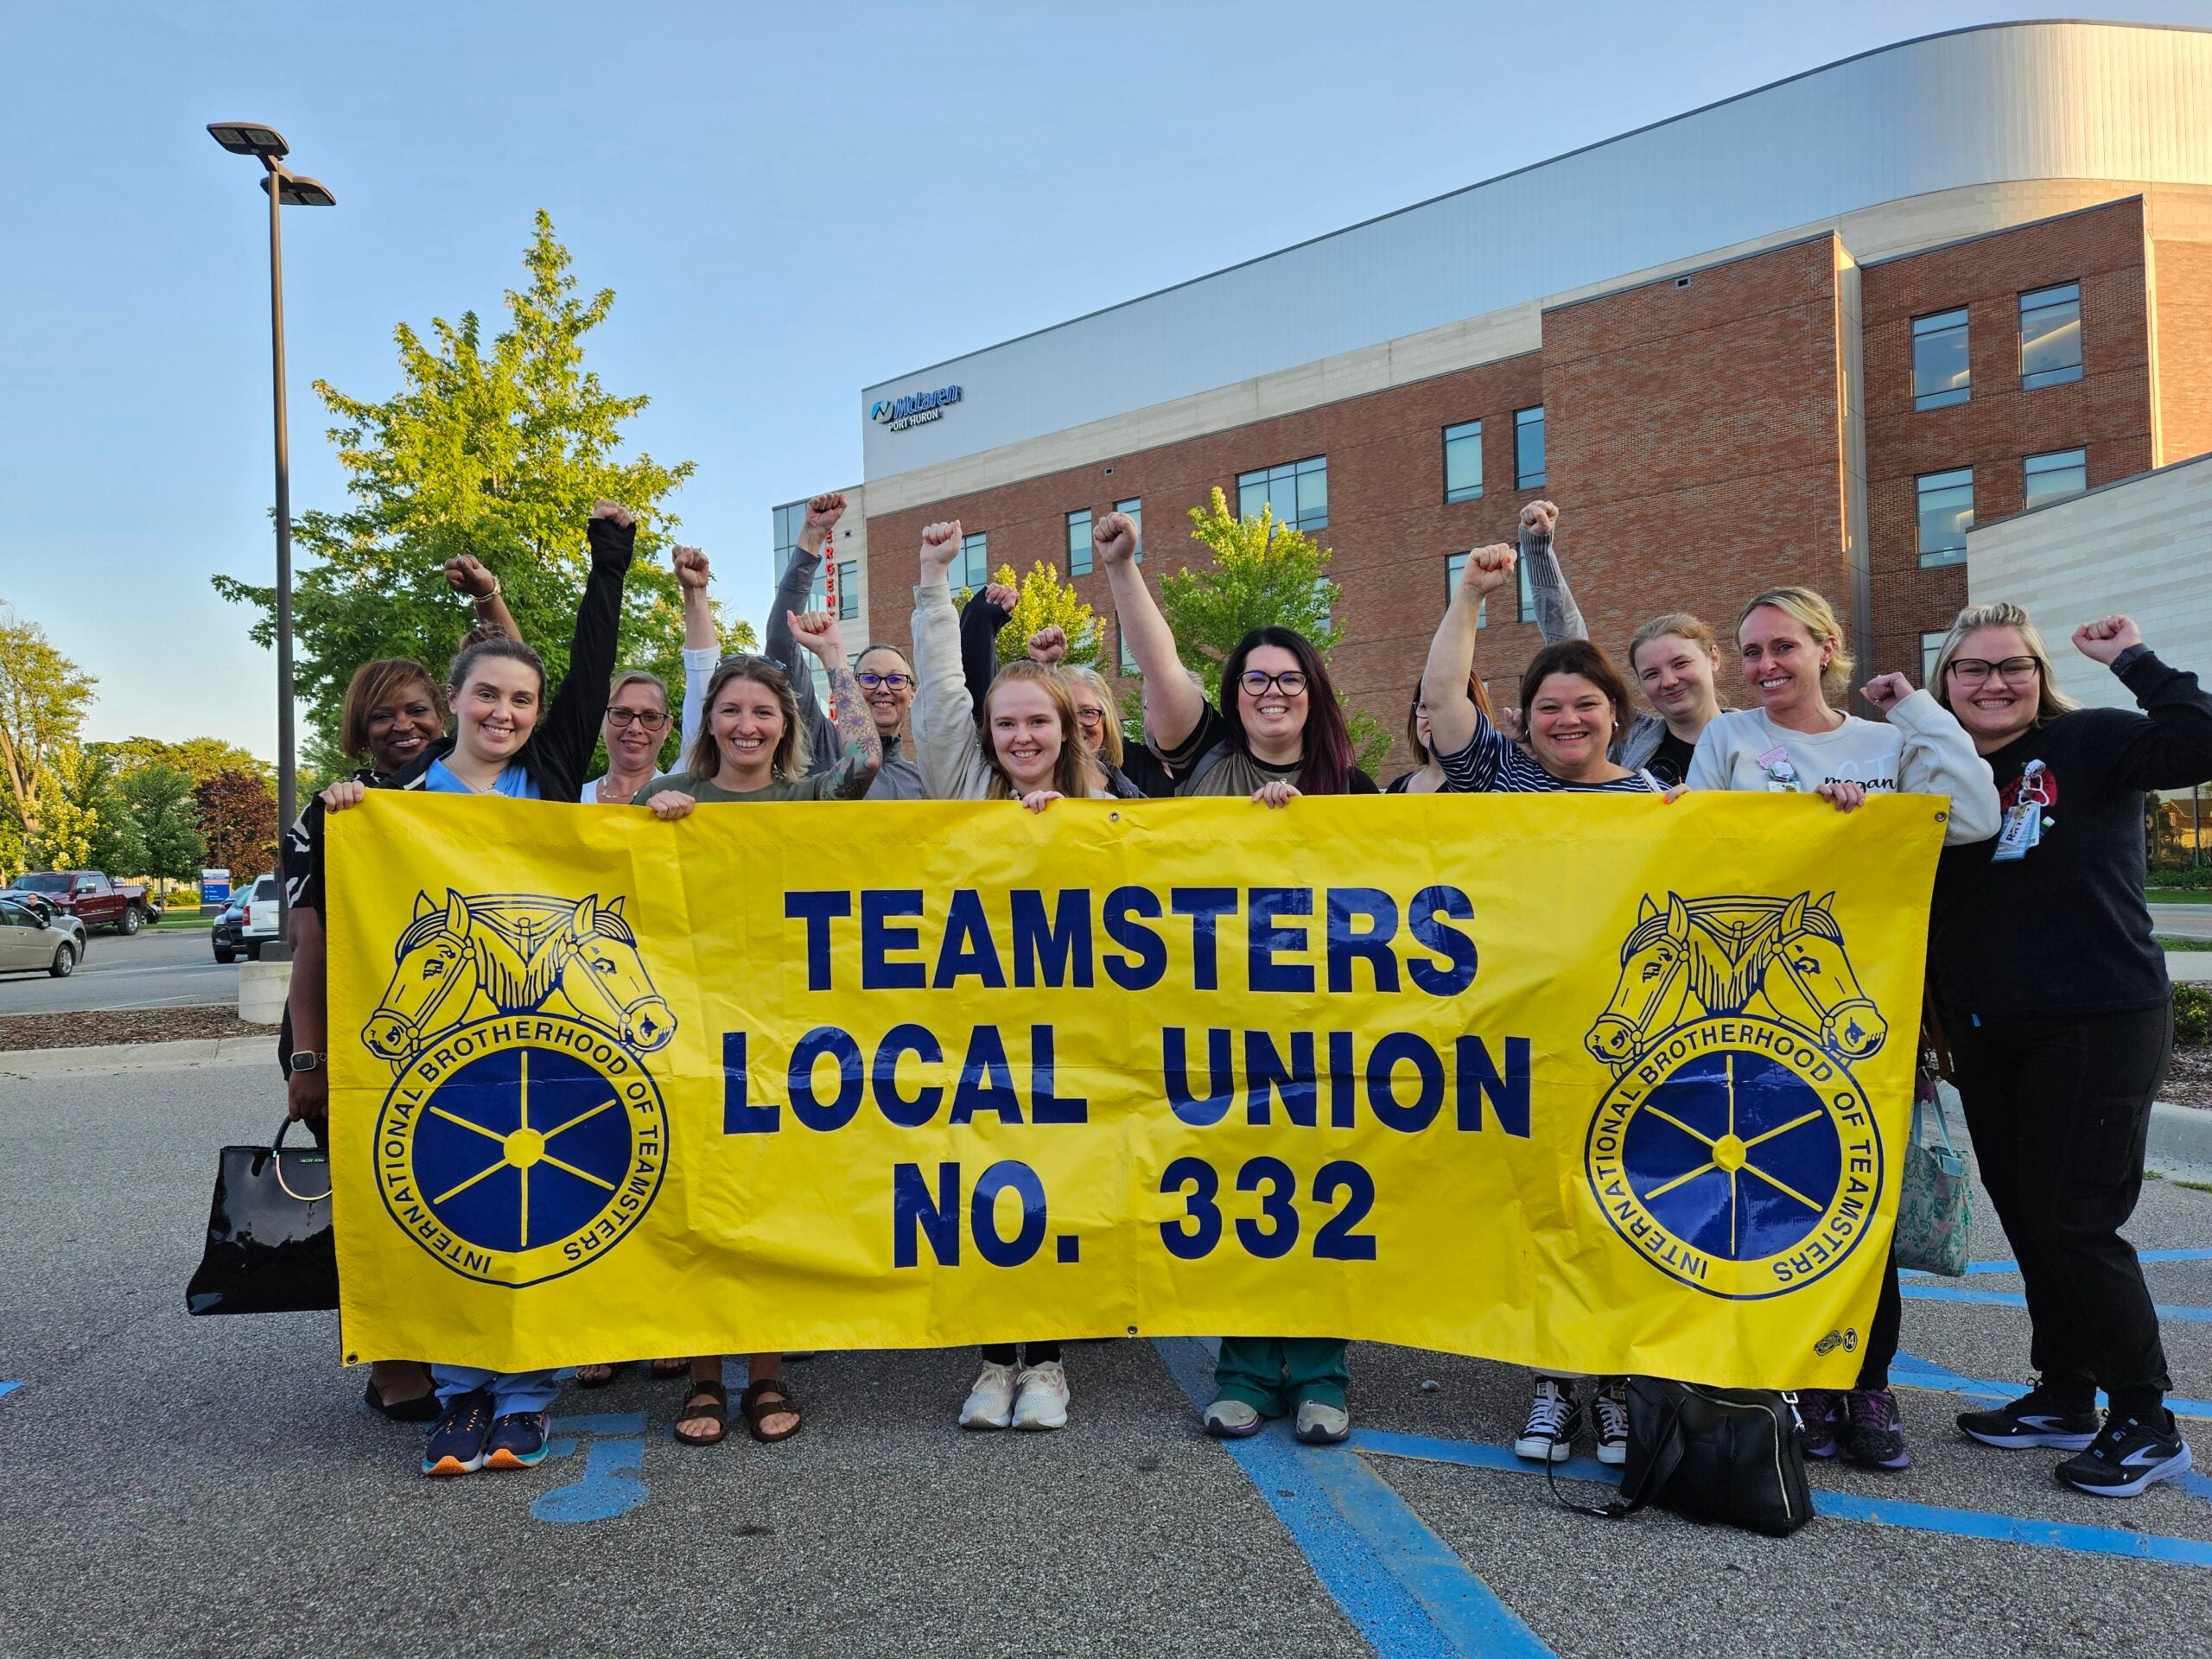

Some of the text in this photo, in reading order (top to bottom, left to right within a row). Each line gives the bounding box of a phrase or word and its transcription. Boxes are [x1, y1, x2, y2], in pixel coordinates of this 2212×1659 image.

[888, 409, 938, 432] PORT HURON
[893, 385, 958, 418] McLaren
[784, 885, 1478, 996] TEAMSTERS
[723, 1023, 1532, 1138] LOCAL UNION
[385, 1020, 658, 1274] INTERNATIONAL BROTHERHOOD OF TEAMSTERS
[1594, 1023, 1871, 1281] INTERNATIONAL BROTHERHOOD OF TEAMSTERS
[893, 1156, 1377, 1268] NO. 332
[1845, 1333, 1855, 1347] 14
